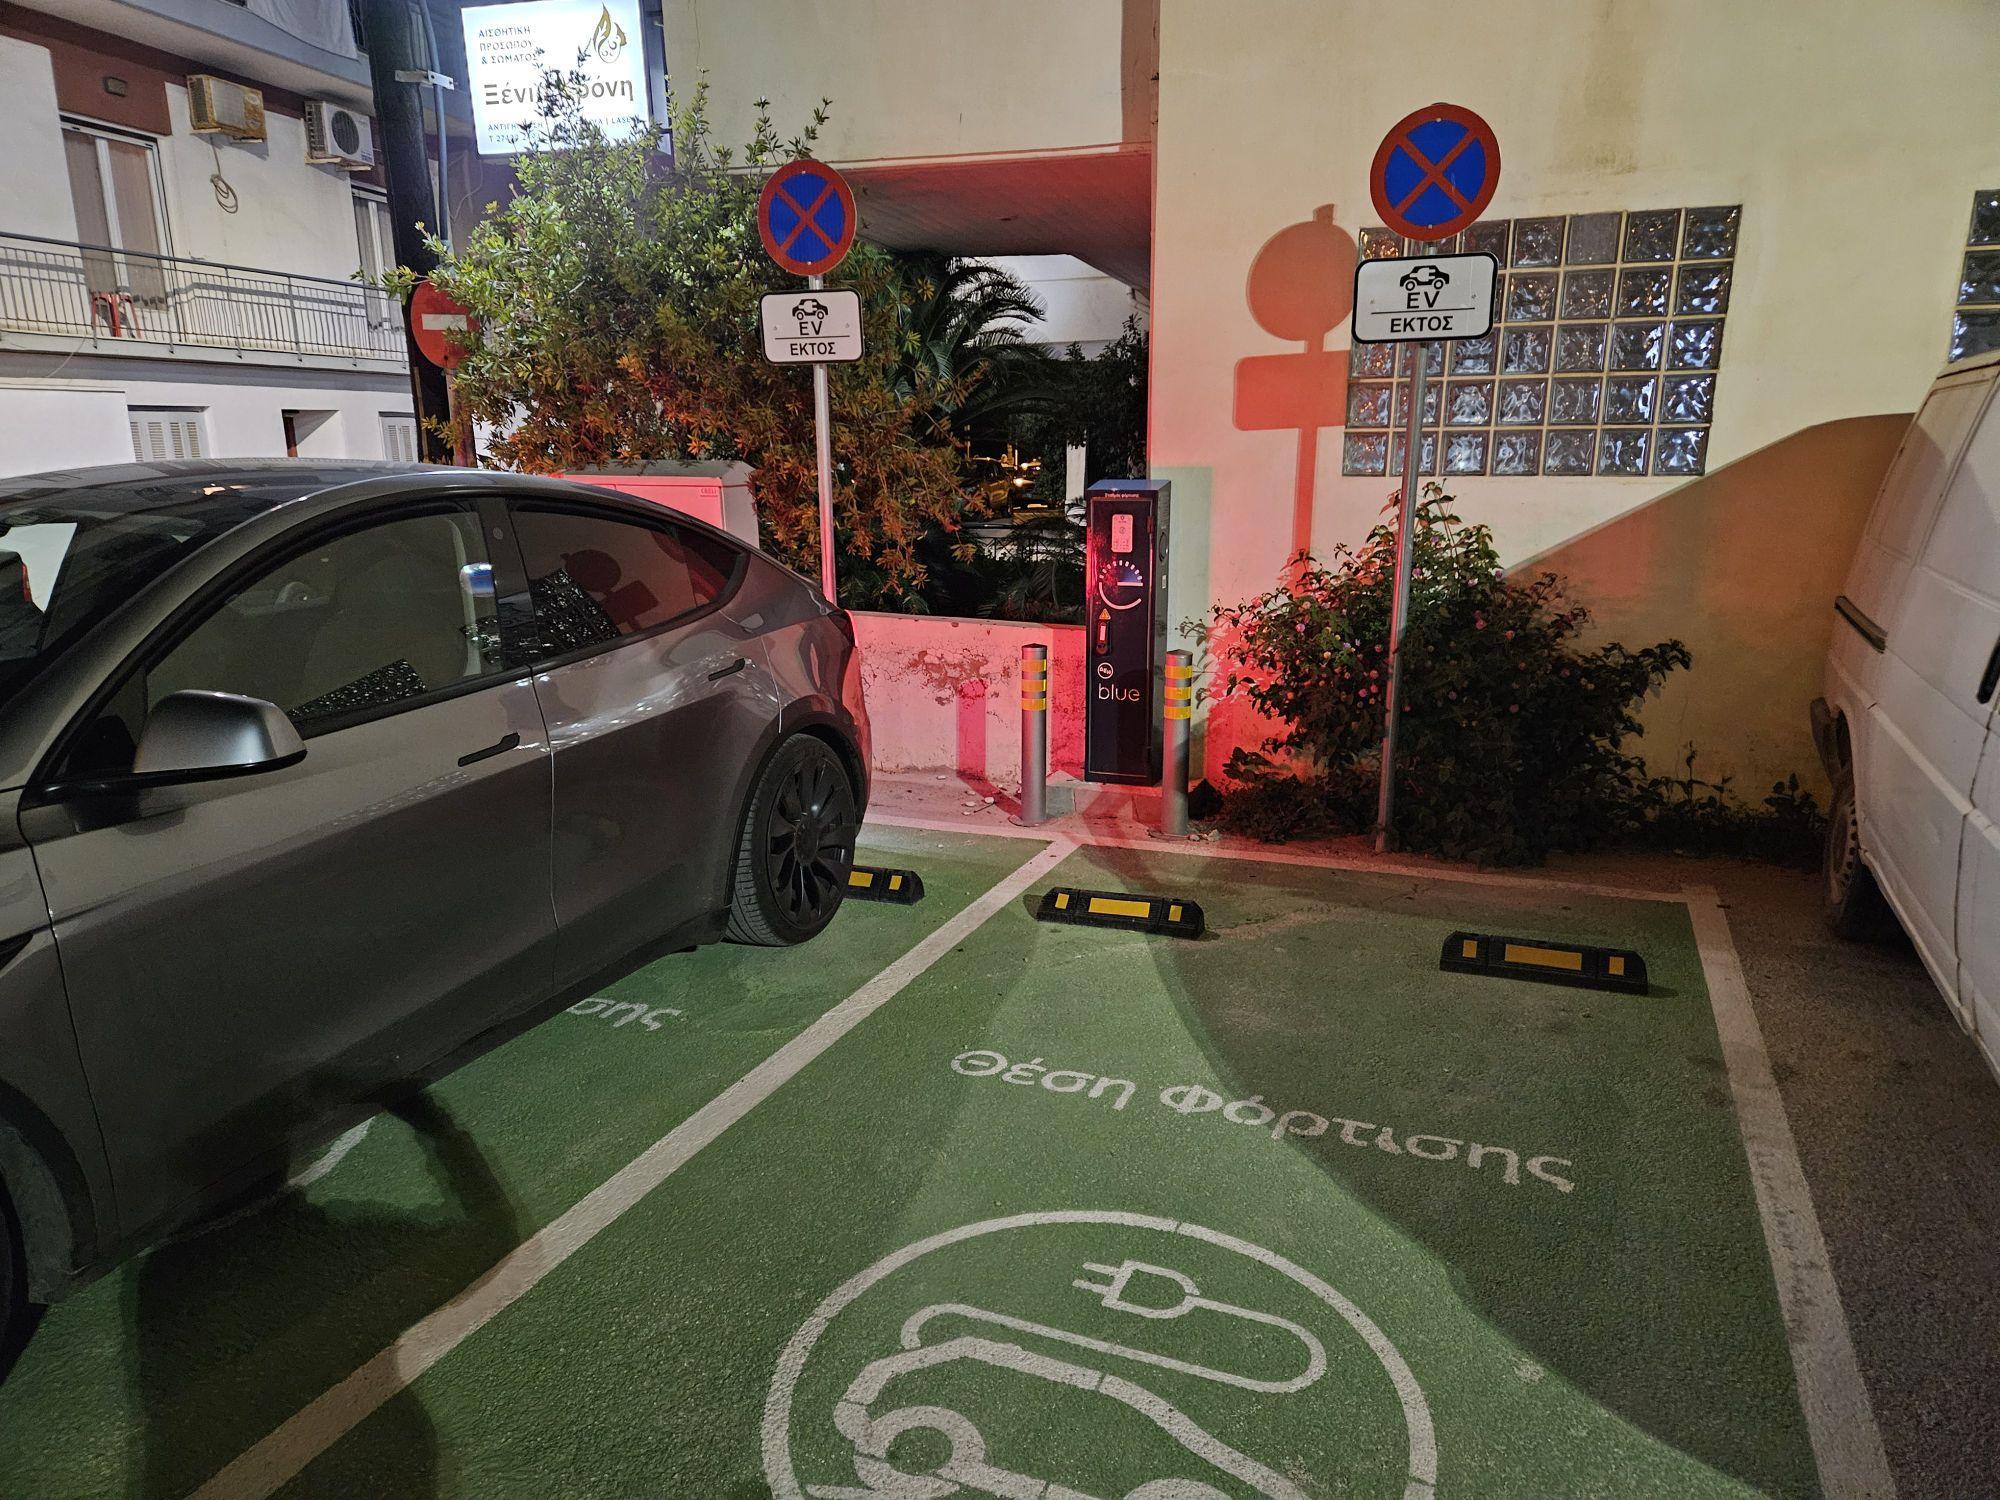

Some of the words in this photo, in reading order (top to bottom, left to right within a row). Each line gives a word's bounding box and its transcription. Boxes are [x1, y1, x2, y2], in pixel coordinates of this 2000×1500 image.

[479, 26, 531, 38] ΑΙΣΘΗΤΙΚΗ
[480, 40, 532, 51] ΠΡΟΣΩΠΟΥ
[481, 56, 487, 65] &
[491, 53, 537, 64] ΣΩΜΑΤΟΣ
[484, 82, 544, 105] Ξένι
[1406, 291, 1440, 310] EV
[799, 321, 823, 336] EV
[1390, 315, 1454, 333] ΕΚΤΟΣ
[790, 342, 836, 356] ΕΚΤΟΣ
[1098, 682, 1140, 702] blue
[565, 997, 682, 1032] σης
[950, 1049, 1135, 1112] Θέση
[1160, 1083, 1576, 1194] Φόρτισης
